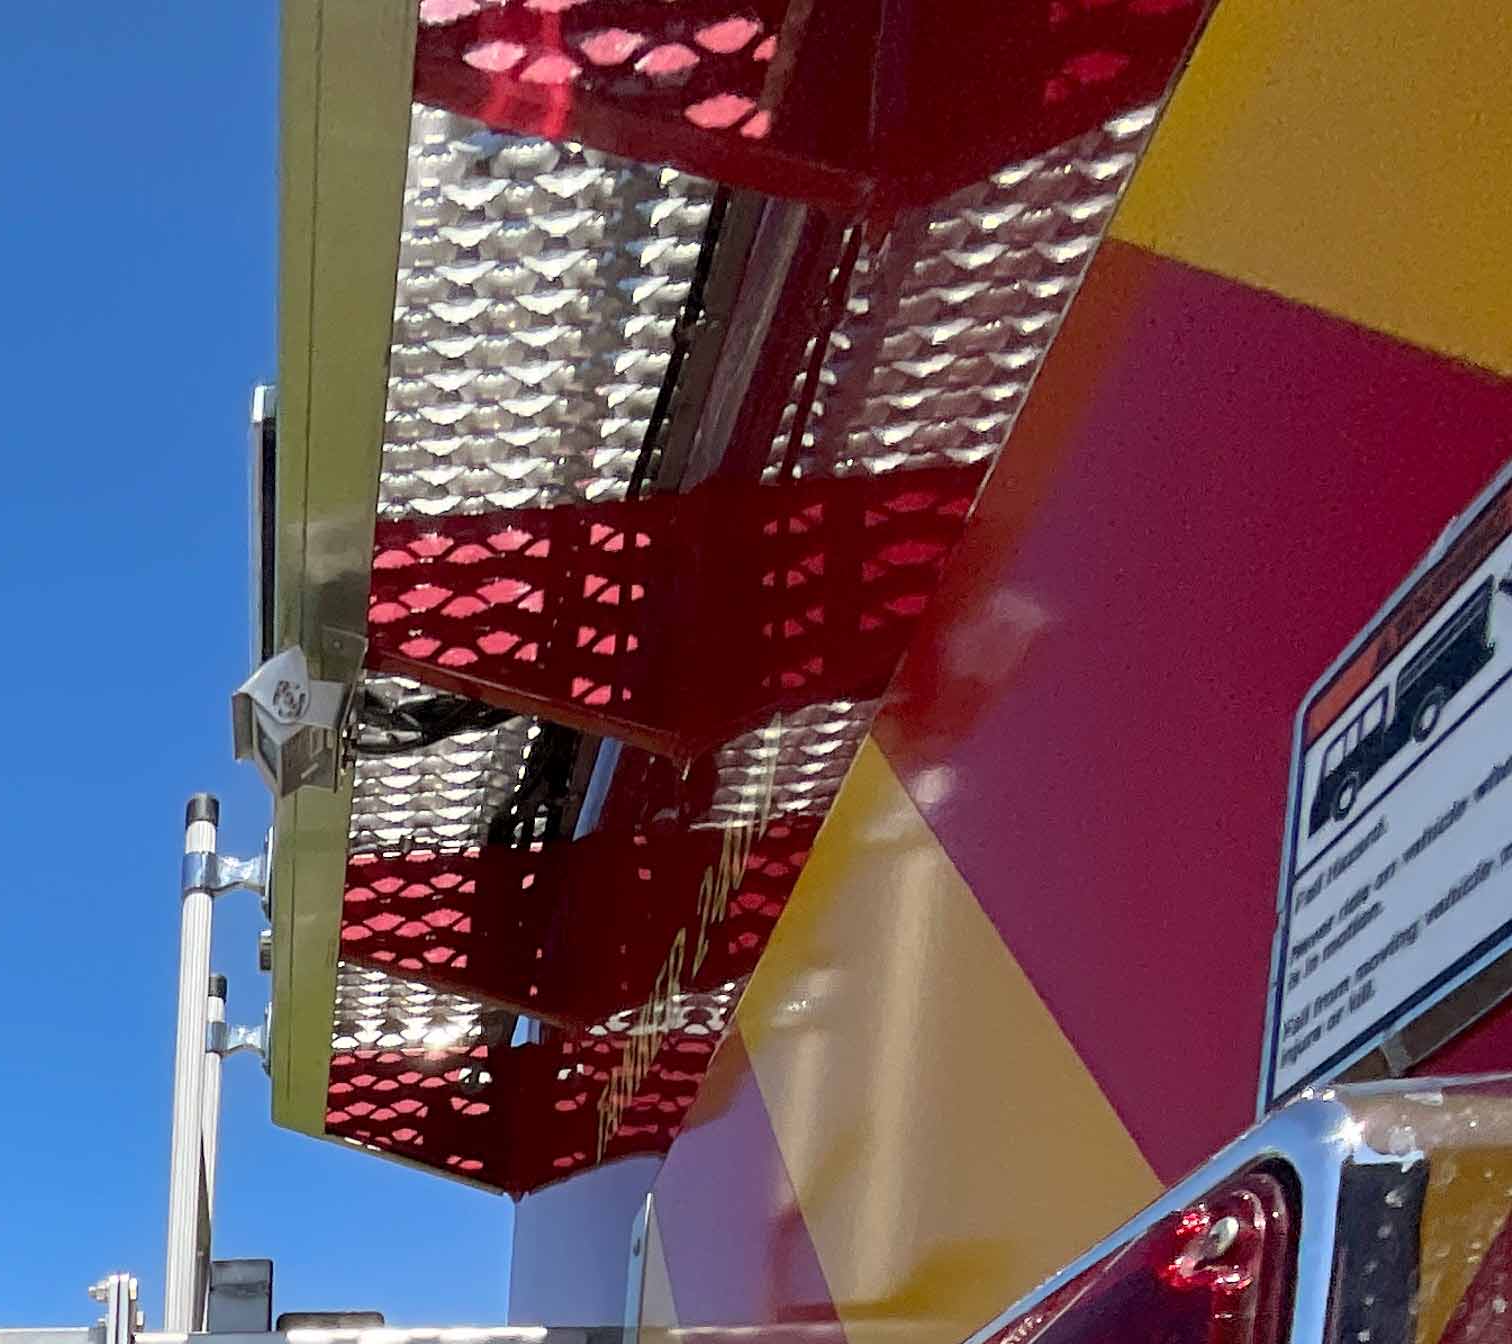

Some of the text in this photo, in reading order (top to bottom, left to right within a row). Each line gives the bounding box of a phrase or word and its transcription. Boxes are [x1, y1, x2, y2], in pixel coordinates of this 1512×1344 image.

[1338, 883, 1371, 922] ride
[1373, 860, 1398, 891] on
[1401, 796, 1469, 864] vehicle
[1313, 975, 1351, 1018] from
[1354, 919, 1420, 982] moving
[1424, 858, 1495, 926] vehicle
[1326, 1005, 1345, 1032] or
